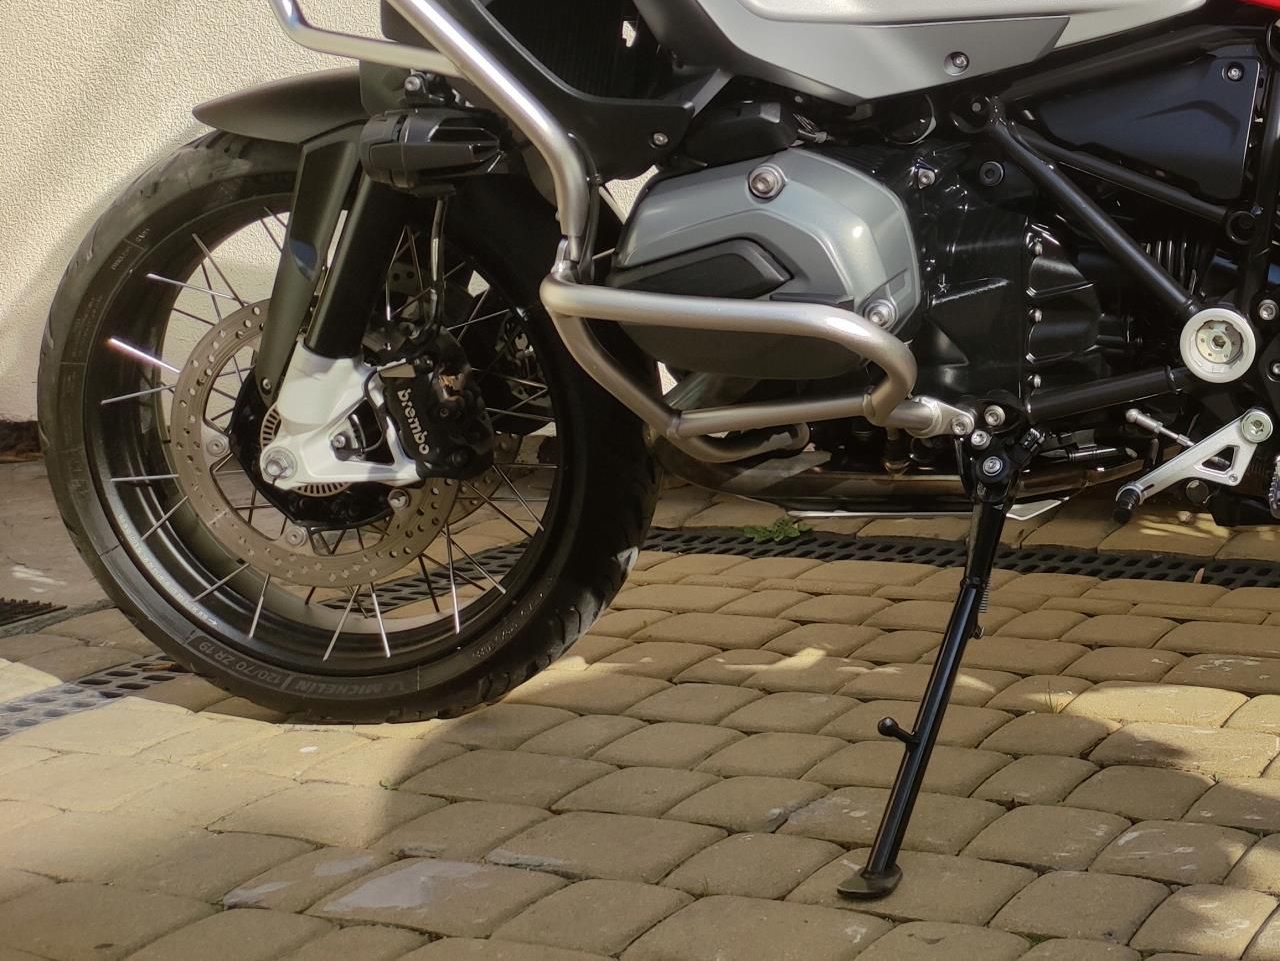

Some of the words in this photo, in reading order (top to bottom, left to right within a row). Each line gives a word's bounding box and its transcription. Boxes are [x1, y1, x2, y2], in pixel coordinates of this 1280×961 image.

[397, 388, 430, 455] brembo
[199, 641, 216, 655] 19
[214, 651, 236, 666] ZR
[236, 661, 282, 685] 120/70
[296, 679, 384, 696] MICHELIN
